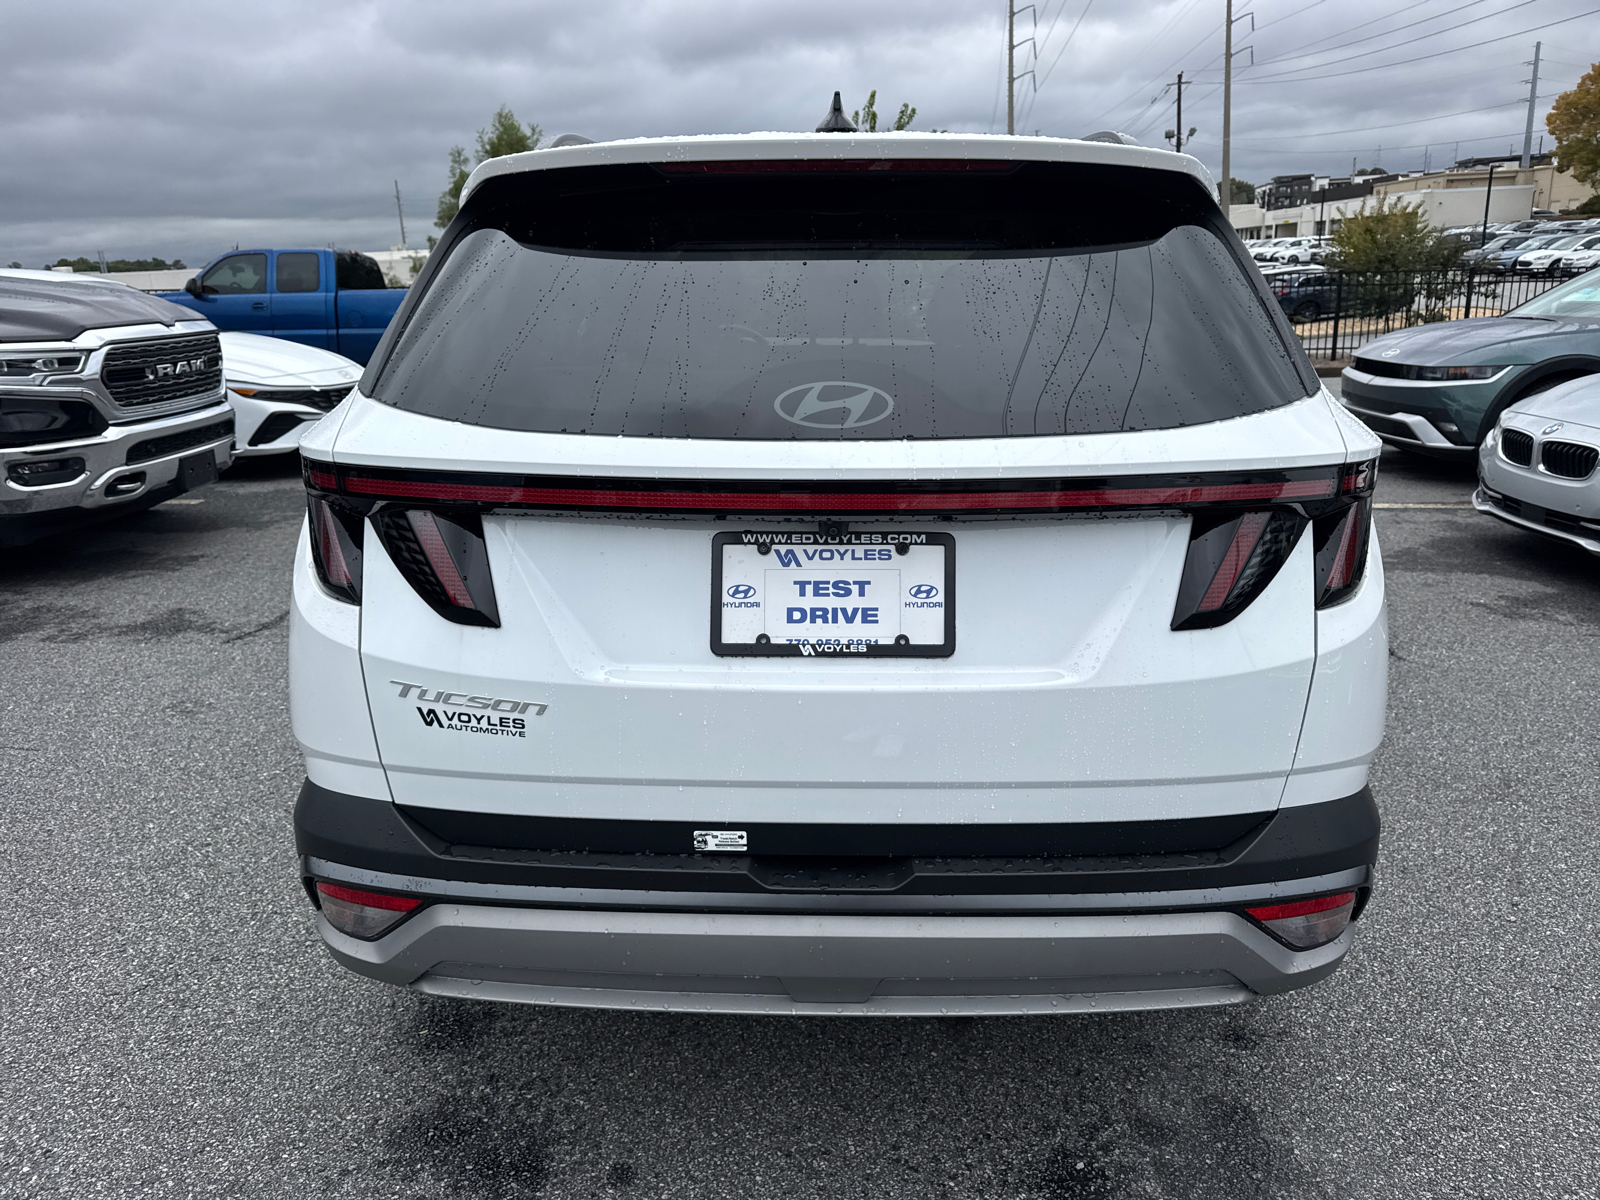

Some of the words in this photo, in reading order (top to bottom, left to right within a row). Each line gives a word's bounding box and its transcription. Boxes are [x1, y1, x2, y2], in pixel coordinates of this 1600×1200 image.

[156, 359, 206, 377] RAM
[742, 533, 927, 544] WWW.EDVOYLES.COM
[802, 548, 893, 561] VOYLES
[793, 580, 871, 597] TEST
[786, 607, 879, 624] DRIVE
[815, 644, 867, 652] VOYLES
[442, 710, 526, 730] VOYLES
[446, 723, 526, 738] AUTOMOTIVE
